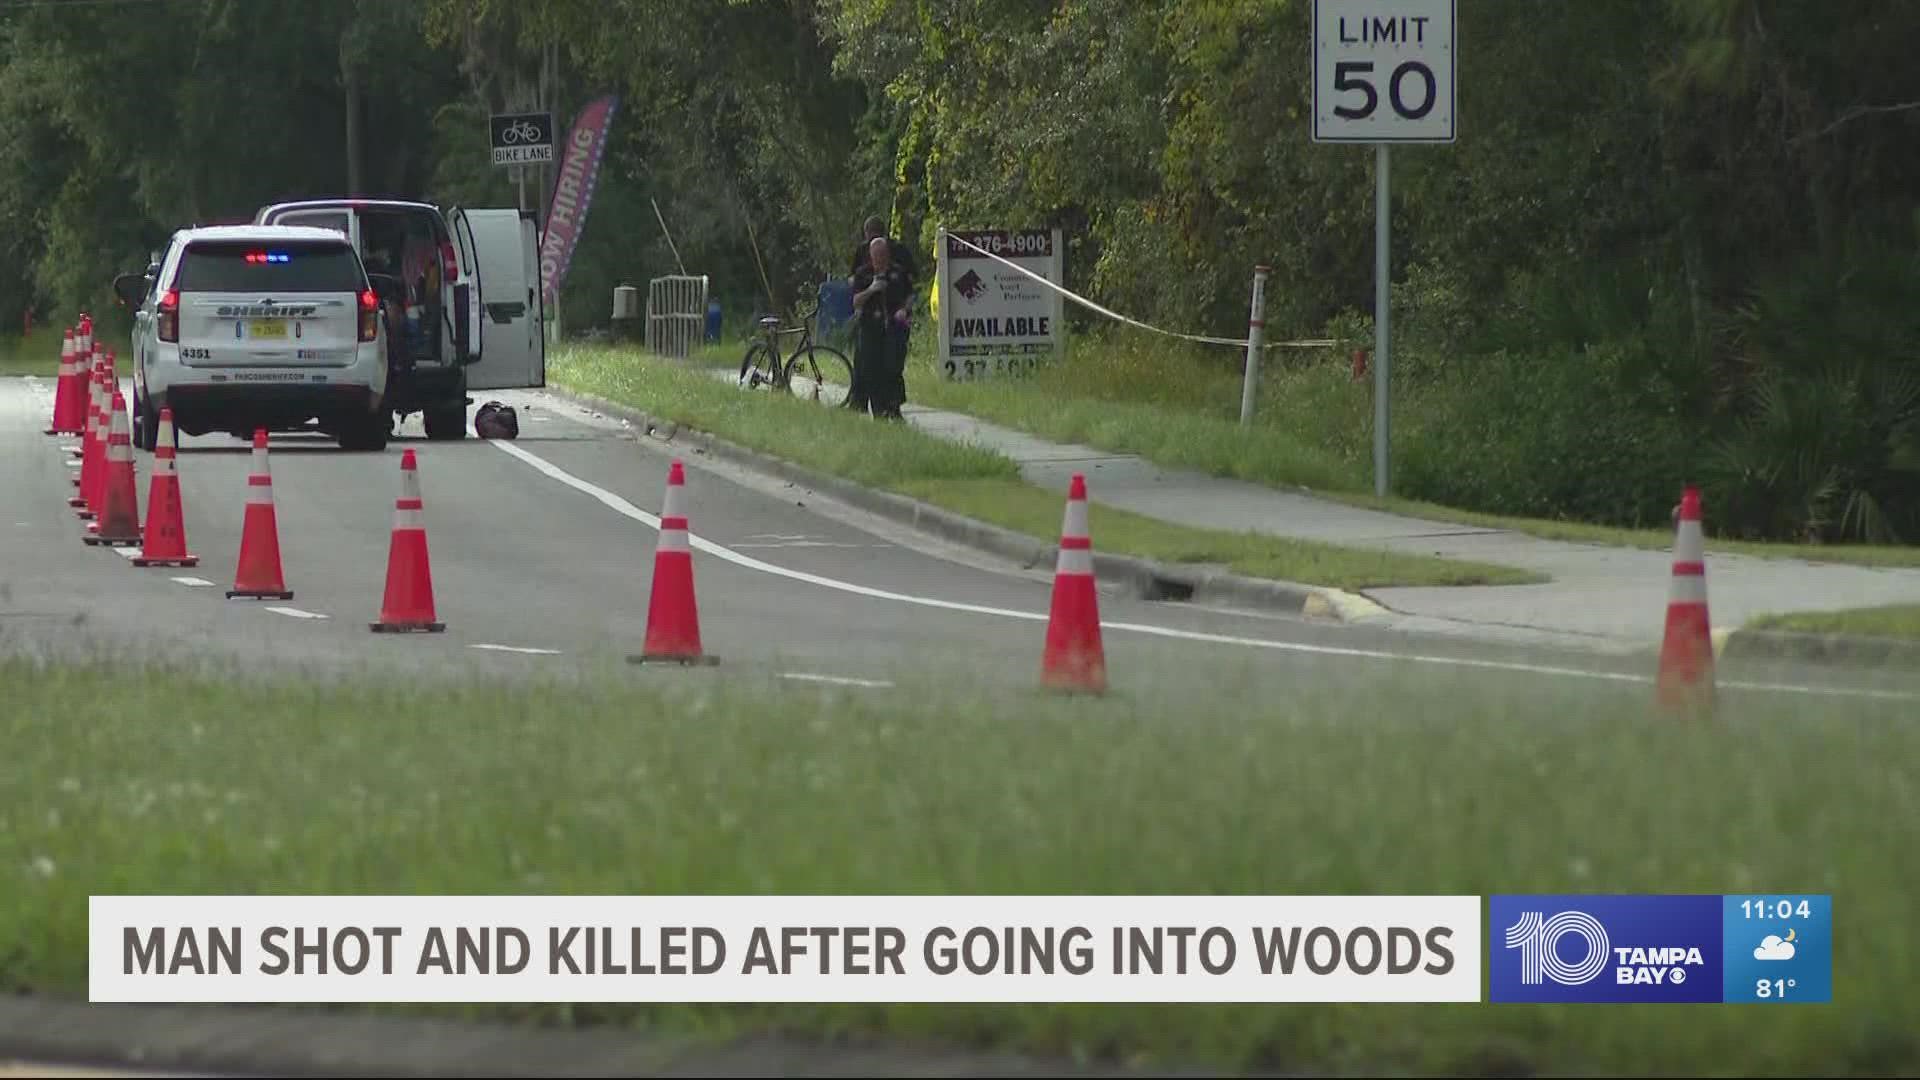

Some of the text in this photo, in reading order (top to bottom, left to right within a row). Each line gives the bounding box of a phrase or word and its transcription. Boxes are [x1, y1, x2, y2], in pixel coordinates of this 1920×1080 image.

[1339, 16, 1430, 43] LIMIT
[1333, 60, 1437, 120] 50
[495, 146, 551, 162] BIKE LANE
[553, 126, 595, 224] HIRING
[216, 304, 317, 317] SHERIFF
[953, 316, 1050, 338] AVAILABLE
